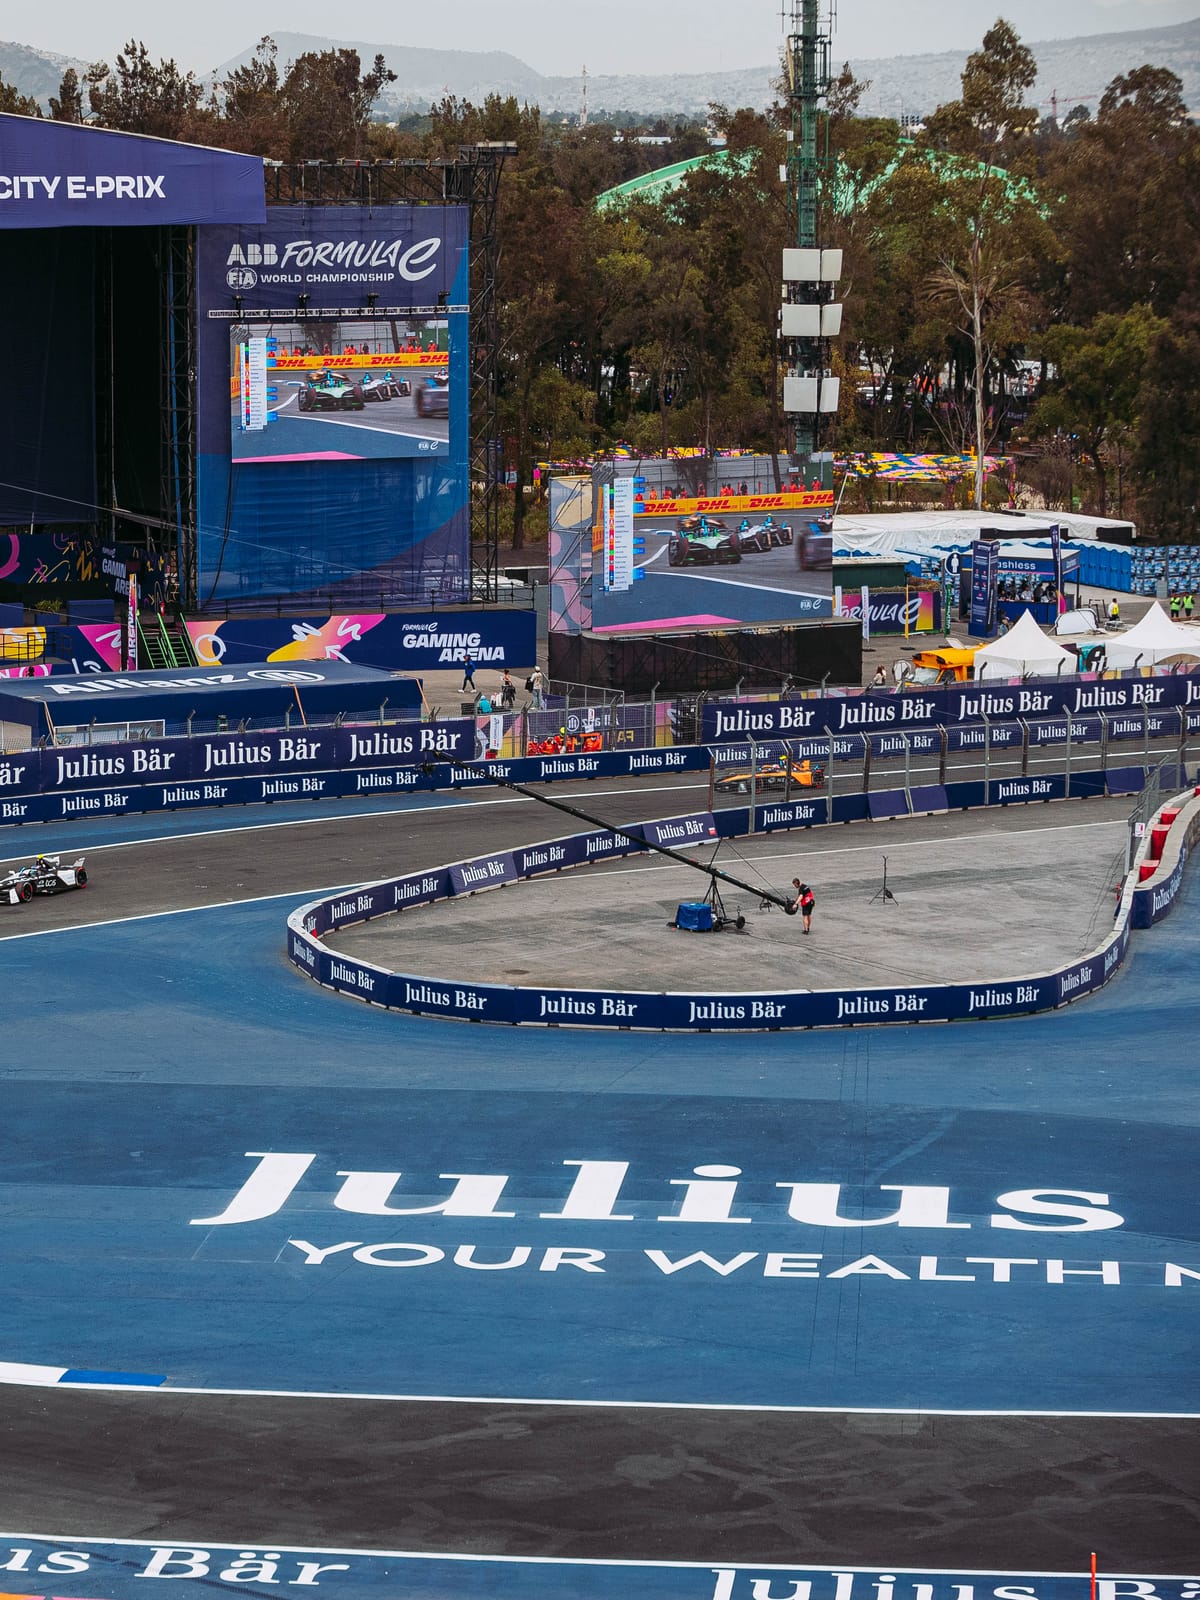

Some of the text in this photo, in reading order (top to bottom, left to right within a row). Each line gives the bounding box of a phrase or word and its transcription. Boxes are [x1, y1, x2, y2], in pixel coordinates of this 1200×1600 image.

[67, 174, 165, 199] E-PRIX
[227, 244, 278, 265] ABB
[281, 240, 402, 268] FORMULA
[227, 269, 394, 288] FIA WORLD CHAMPIONSHIP
[323, 356, 403, 366] DHL DHL
[645, 497, 784, 512] DHL DHL DHL
[403, 633, 480, 648] GAMING
[439, 647, 505, 662] ARENA
[44, 674, 252, 695] Allianz
[959, 691, 1052, 721] Julius Bär
[1074, 687, 1126, 712] Julius
[1132, 684, 1164, 704] Bär
[715, 707, 815, 736] Julius Bär
[839, 699, 935, 728] Julius Bär
[205, 738, 320, 771] Julius Bär
[350, 729, 460, 761] Julius Bär
[57, 749, 175, 784] Julius Bär
[541, 759, 599, 776] Julius Bär
[630, 753, 686, 770] Julius Bär
[262, 778, 325, 797] Julius Bär
[357, 772, 418, 790] Julius Bär
[999, 781, 1052, 799] Julius Bär
[163, 786, 227, 805] Julius Bär
[3, 803, 27, 817] Bär
[764, 806, 814, 826] Julius Bär
[656, 825, 685, 842] Julius
[524, 852, 547, 871] Julius
[395, 884, 420, 904] Julius
[332, 902, 355, 923] Julius
[331, 961, 374, 990] Julius Bär
[406, 984, 487, 1009] Julius Bär
[540, 996, 637, 1016] Julius Bär
[838, 995, 927, 1018] Julius Bär
[969, 986, 1039, 1011] Julius Bär
[690, 1002, 785, 1022] Julius Bär
[189, 1152, 1125, 1231] Julius
[288, 1240, 1120, 1286] YOUR WEALTH
[134, 1547, 350, 1588] Bär
